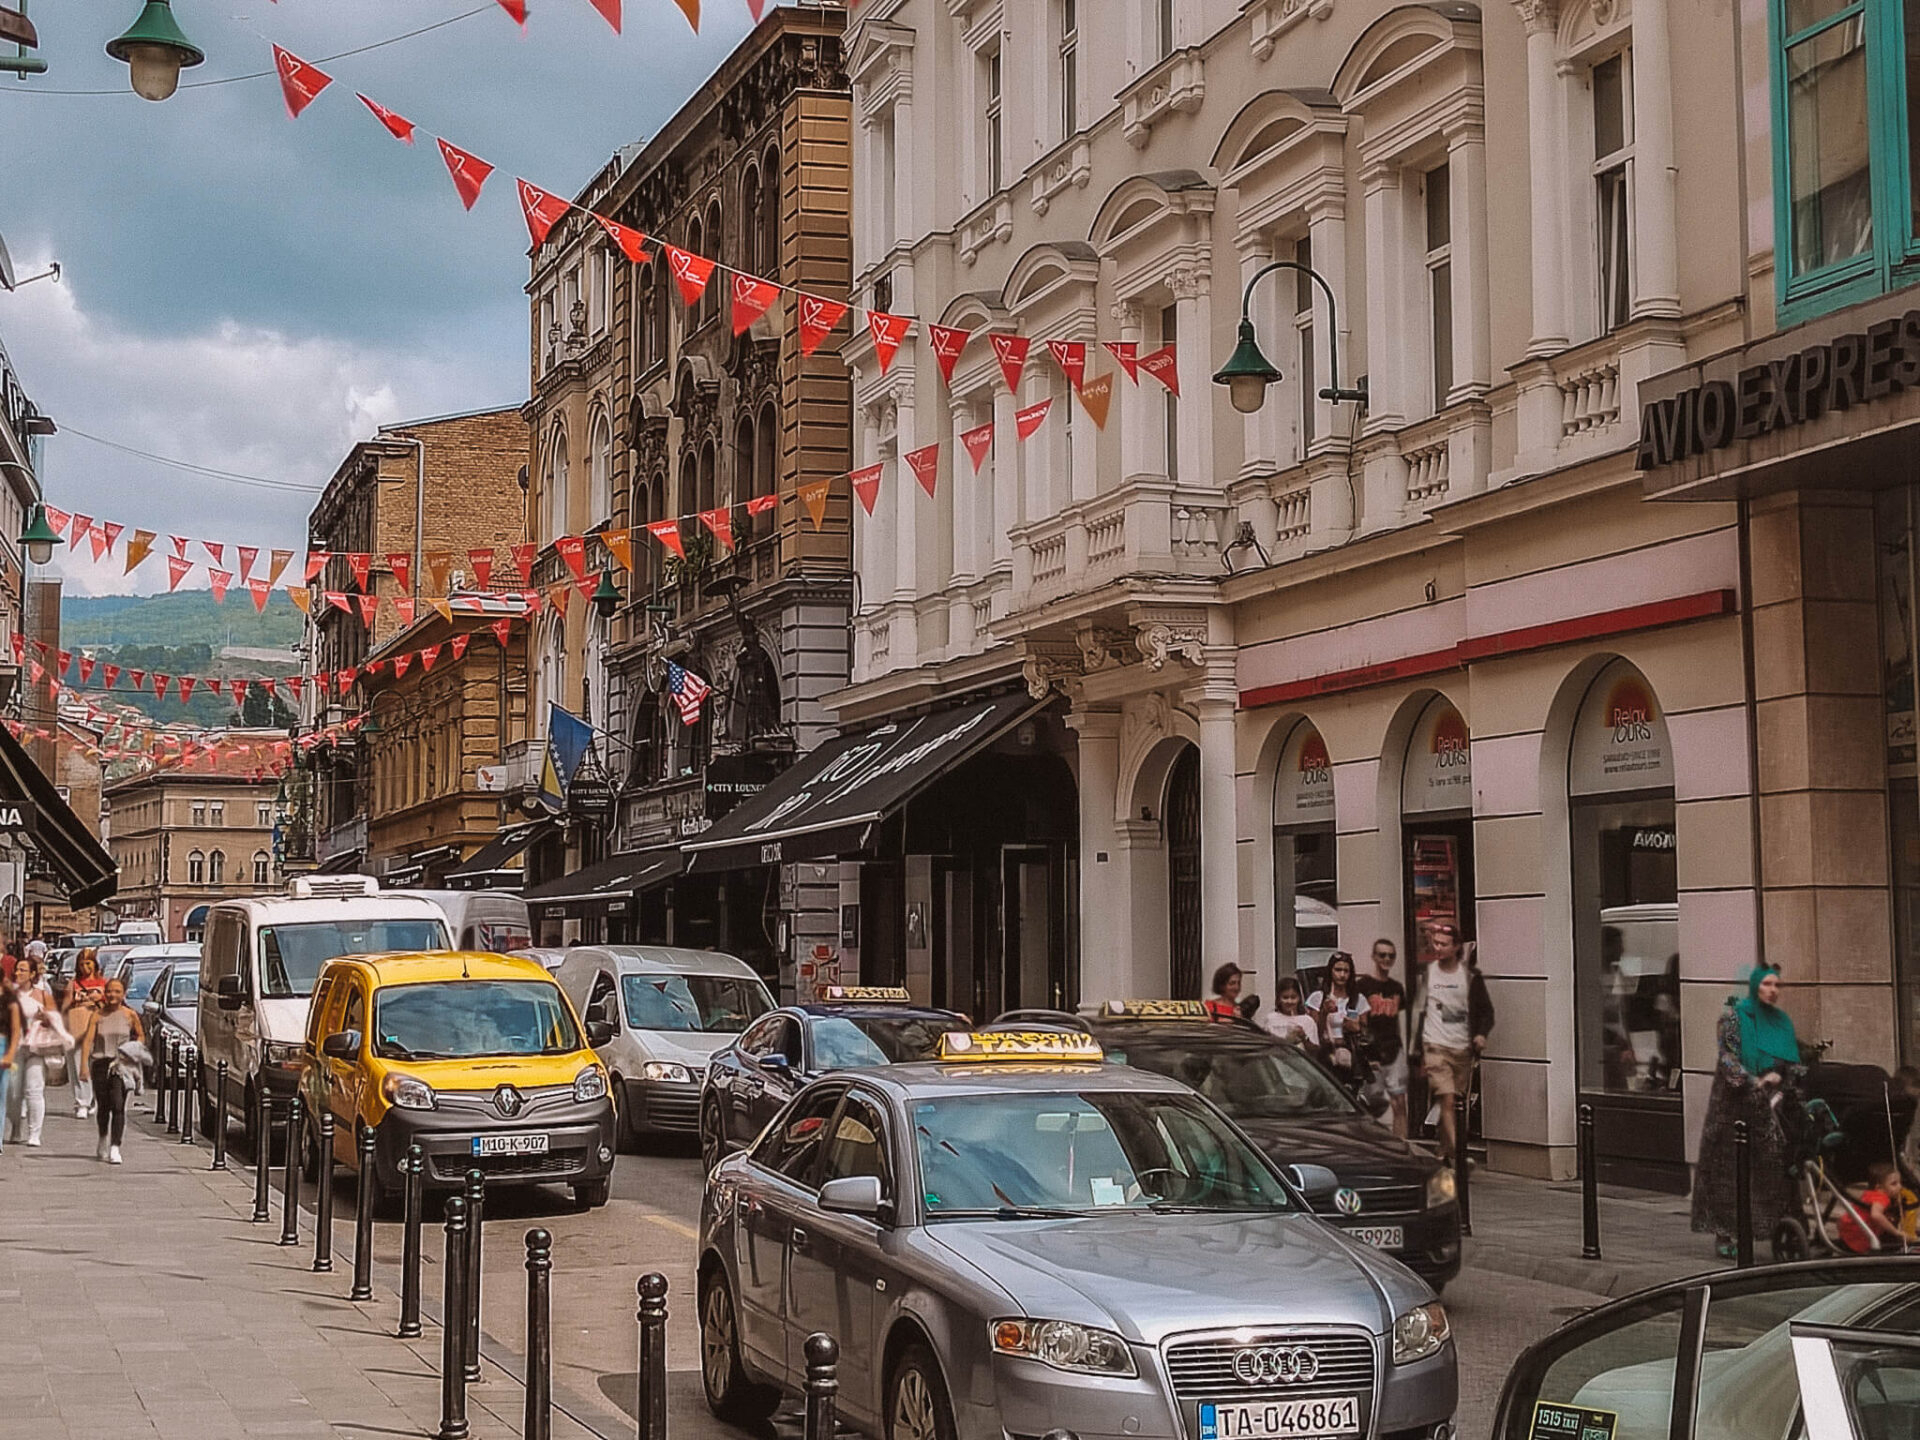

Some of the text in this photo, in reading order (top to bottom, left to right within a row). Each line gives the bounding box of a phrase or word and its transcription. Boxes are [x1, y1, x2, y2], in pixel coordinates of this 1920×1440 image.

[1613, 707, 1647, 728] Relax
[714, 783, 732, 792] CITY
[482, 1136, 546, 1151] M10-K-907
[1218, 1402, 1357, 1436] TA-046861
[1538, 1409, 1562, 1426] 1515
